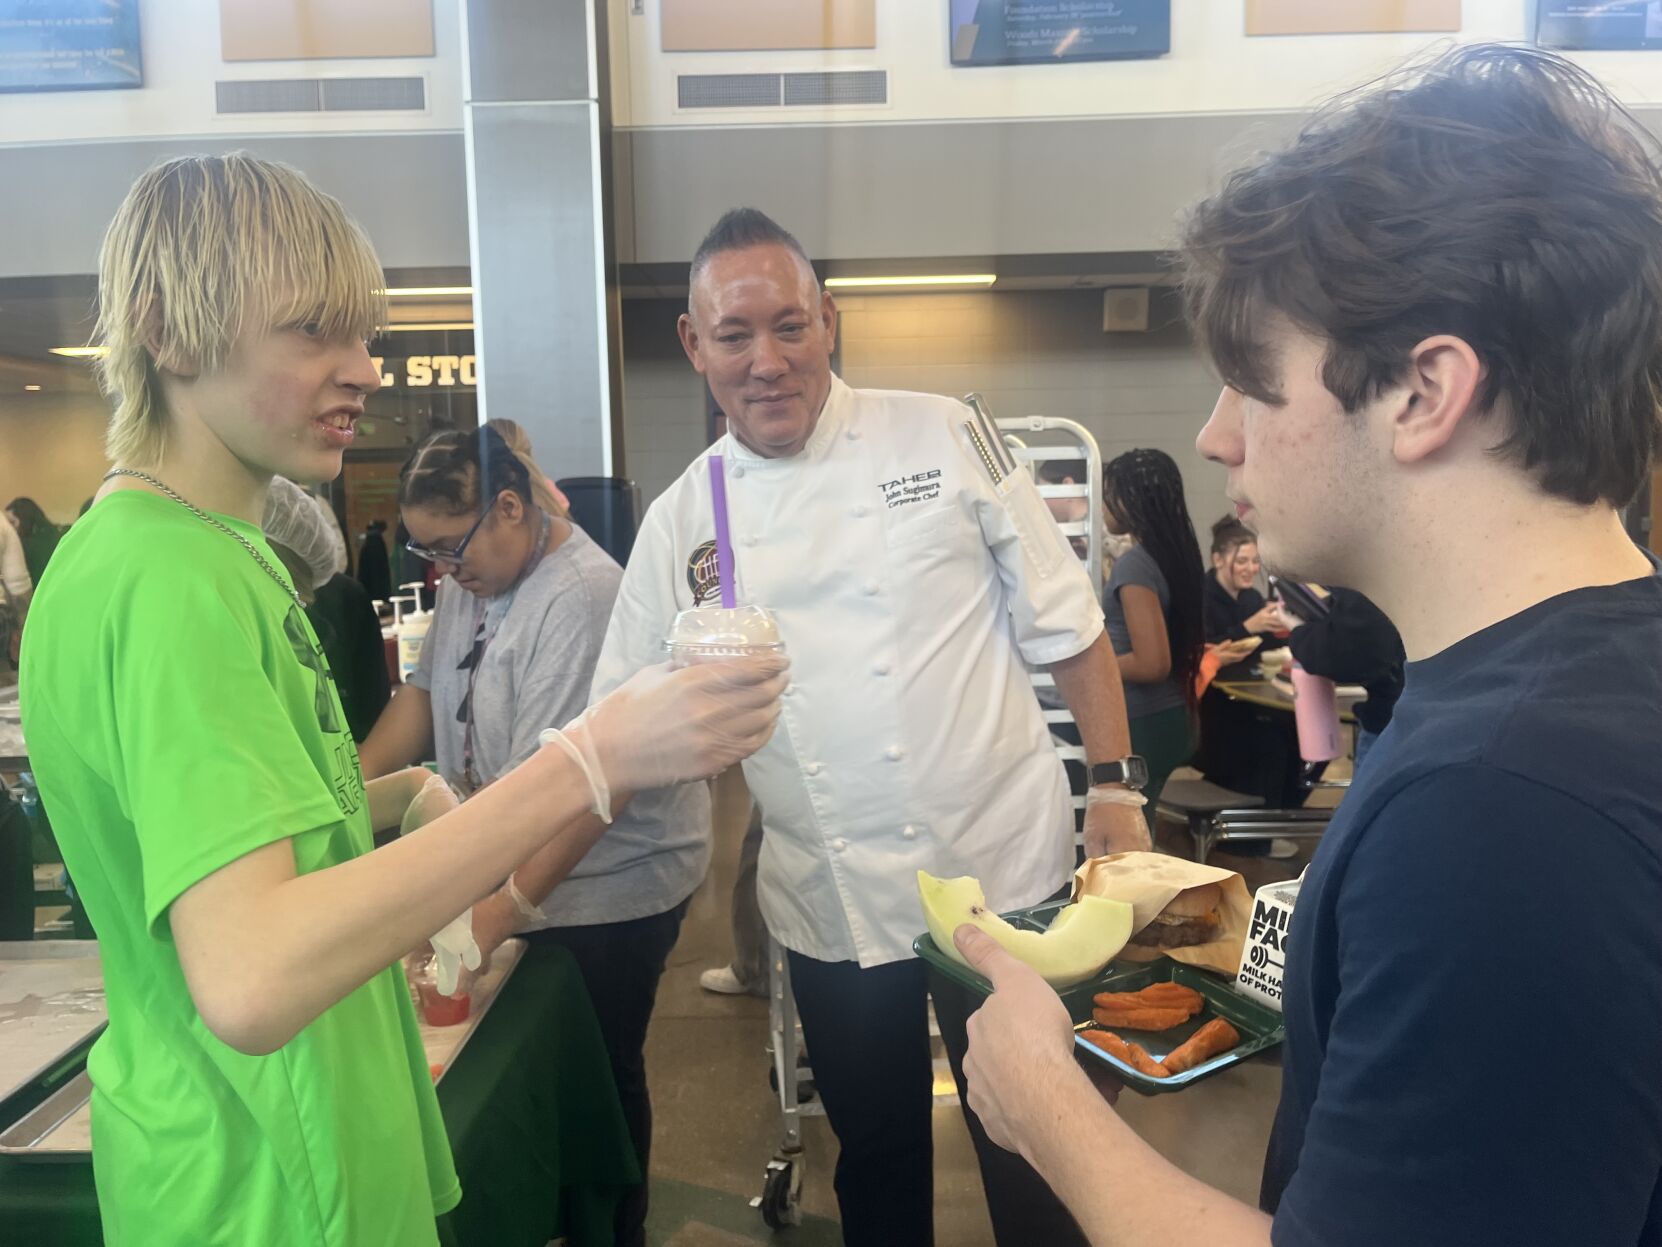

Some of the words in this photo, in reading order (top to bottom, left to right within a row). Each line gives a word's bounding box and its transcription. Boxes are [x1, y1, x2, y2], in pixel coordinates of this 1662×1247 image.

[878, 469, 942, 492] TAHER
[886, 490, 902, 503] John
[888, 496, 922, 509] Corporate
[922, 491, 939, 501] Chef
[1239, 973, 1254, 986] OF
[1242, 963, 1267, 982] MILK
